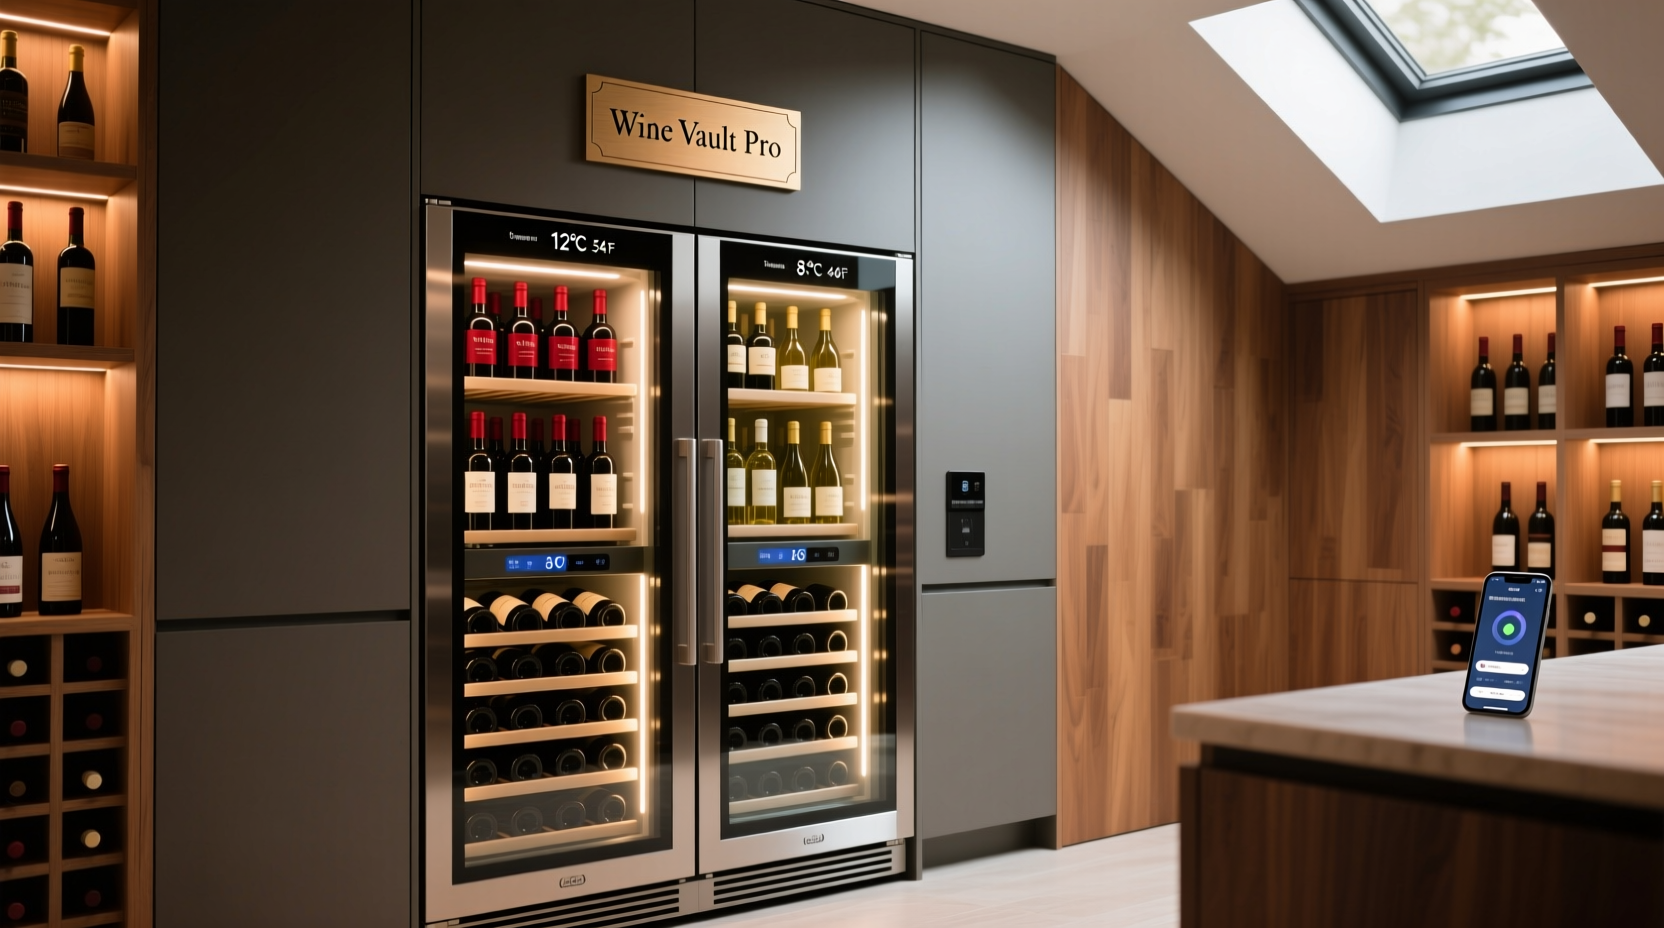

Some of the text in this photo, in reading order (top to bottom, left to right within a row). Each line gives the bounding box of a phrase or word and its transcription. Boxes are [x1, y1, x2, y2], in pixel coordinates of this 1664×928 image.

[609, 107, 782, 158] Wine Vault Pro
[551, 231, 587, 252] 12°C
